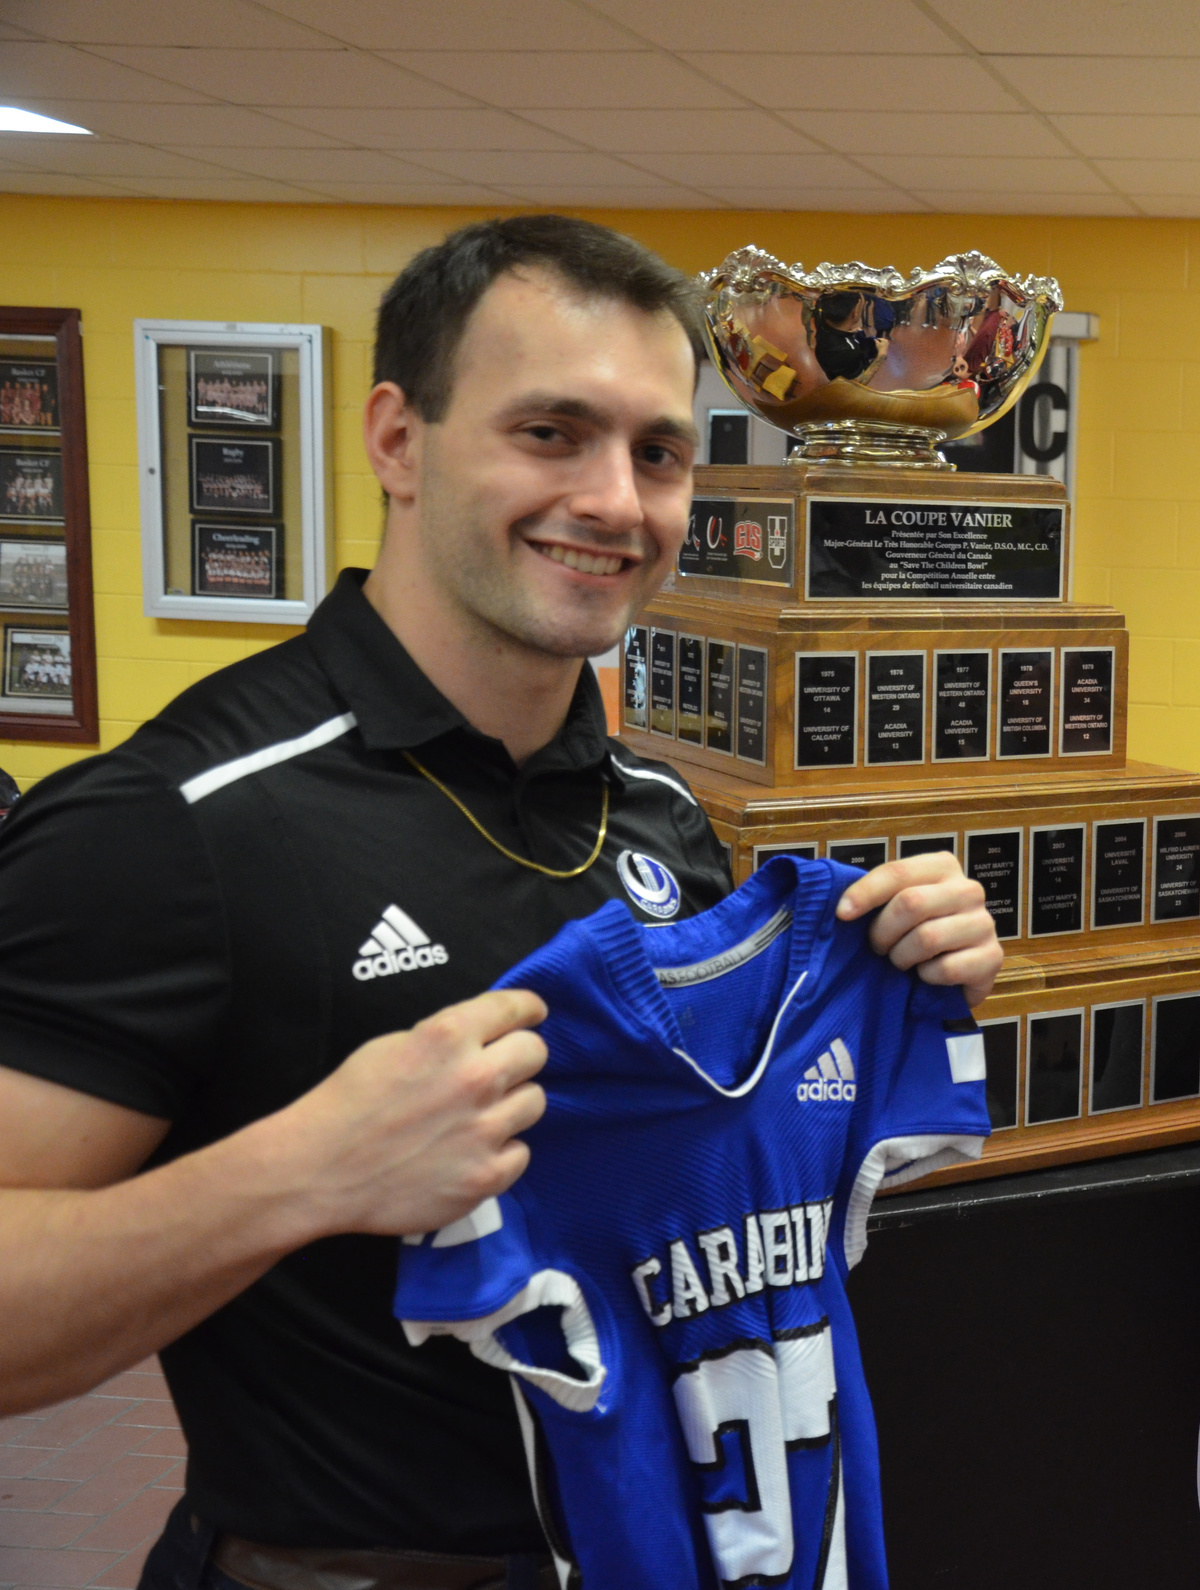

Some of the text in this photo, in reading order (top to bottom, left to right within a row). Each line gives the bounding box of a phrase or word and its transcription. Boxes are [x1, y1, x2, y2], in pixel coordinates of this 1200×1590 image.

[865, 510, 1013, 528] LA COUPE VANIER
[891, 530, 988, 541] Présentée par Son Excellence
[823, 539, 873, 549] Major-Général
[874, 540, 883, 548] Le
[883, 540, 899, 548] Très
[899, 540, 934, 549] Honorable
[935, 541, 962, 551] Georges
[963, 541, 969, 549] P.
[969, 541, 993, 551] Vanier,
[1035, 543, 1049, 551] C.D.
[885, 551, 992, 560] Gouverneur Général du Canada
[921, 561, 935, 569] The
[935, 561, 966, 569] Children
[899, 571, 906, 579] la
[907, 571, 950, 580] Compétition
[861, 581, 872, 589] les
[873, 581, 901, 591] équipes
[911, 581, 939, 590] football
[940, 582, 982, 590] universitaire
[983, 582, 1013, 590] canadien
[1013, 680, 1039, 688] QUEEN'S
[803, 686, 840, 694] UNIVERSITY
[1069, 714, 1096, 722] UNIVERSITY
[1002, 724, 1047, 733] BRITISH COLUMBIA
[1087, 721, 1109, 729] ONTARIO
[877, 731, 913, 739] UNIVERSITY
[944, 727, 979, 735] UNIVERSITY
[1159, 844, 1200, 854] WILFRID LAURIER
[1104, 849, 1136, 859] UNIVERSITÉ
[1165, 852, 1194, 860] UNIVERSITY
[992, 861, 1014, 869] MARY'S
[1042, 856, 1075, 865] UNIVERSITÉ
[976, 869, 1012, 878] UNIVERSITY
[1049, 865, 1068, 873] LAVAL
[1160, 881, 1189, 889] UNIVERSITY
[1100, 887, 1130, 895] UNIVERSITY
[1157, 887, 1200, 898] SASKATCHEWAN
[1004, 898, 1012, 906] OF
[1038, 895, 1055, 903] SAINT
[1097, 893, 1142, 904] SASKATCHEWAN
[1041, 901, 1074, 910] UNIVERSITY
[352, 943, 449, 981] adidas
